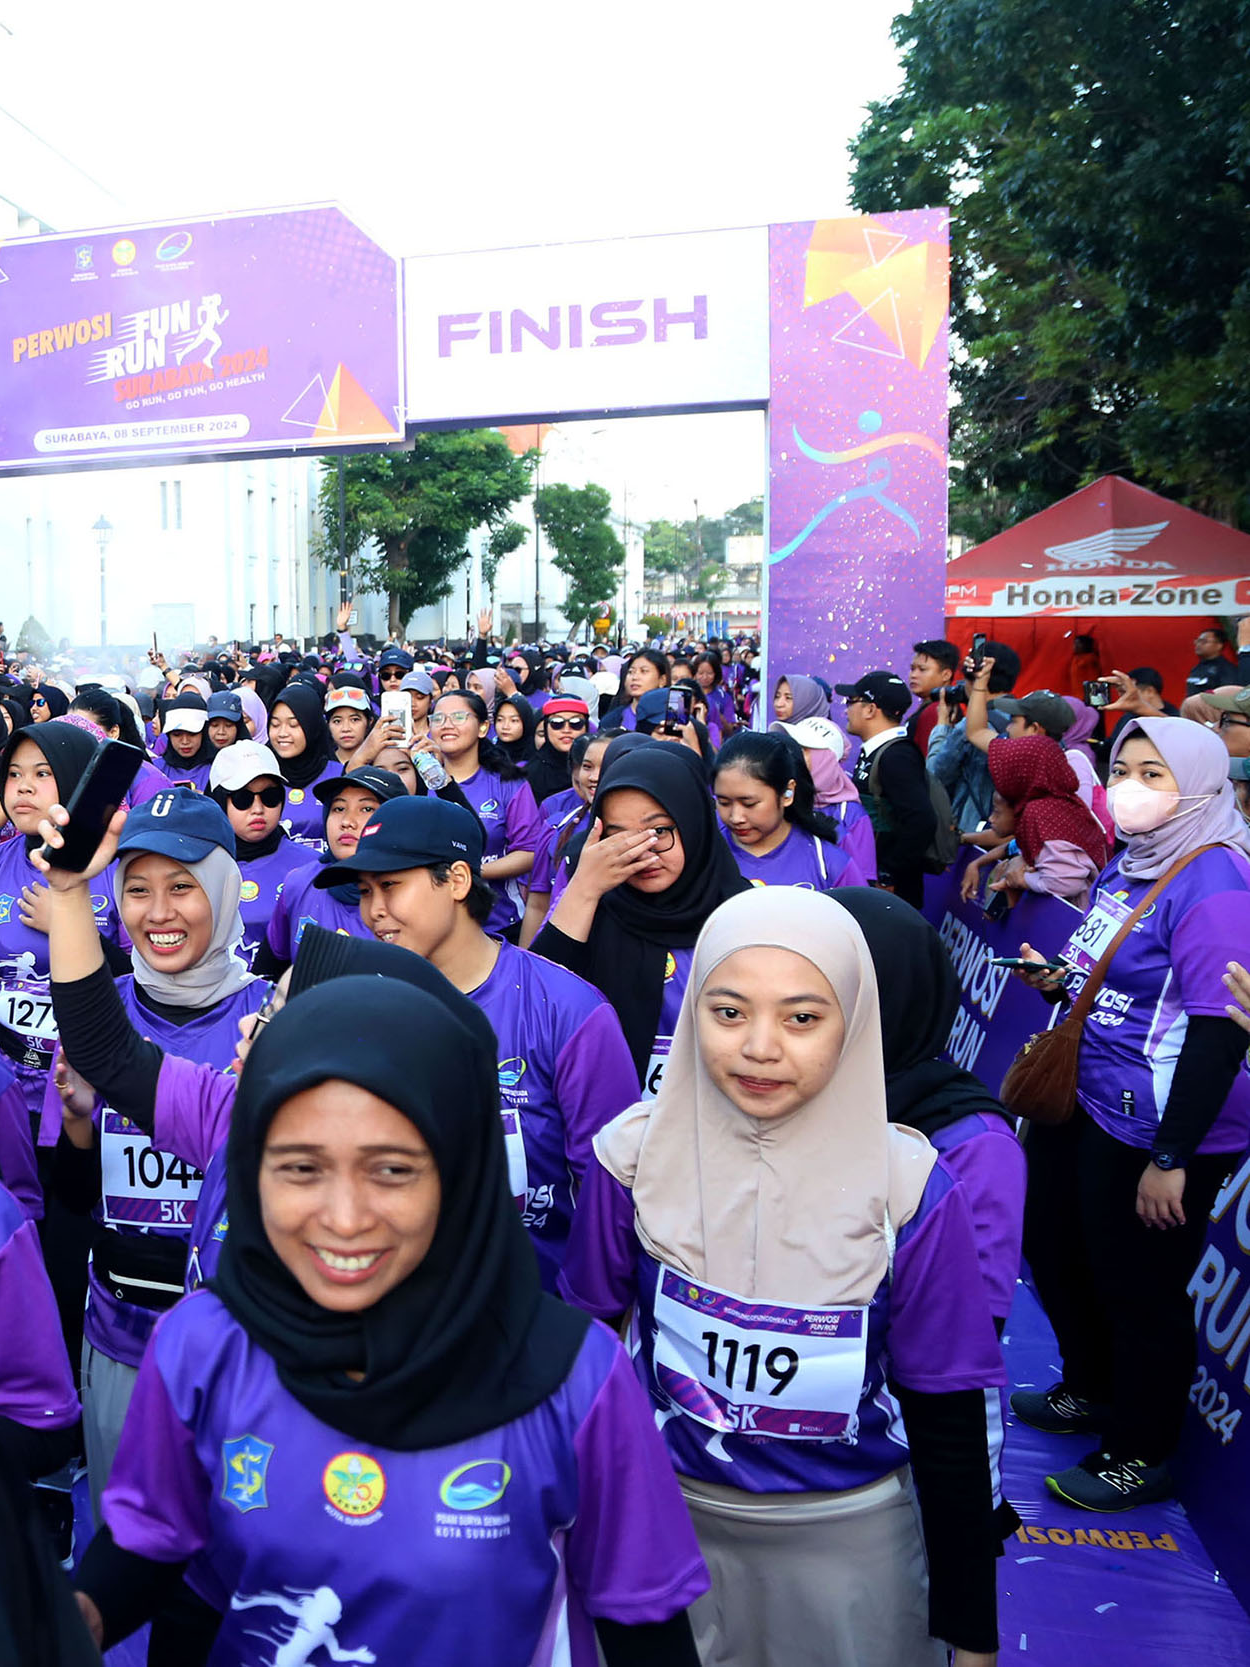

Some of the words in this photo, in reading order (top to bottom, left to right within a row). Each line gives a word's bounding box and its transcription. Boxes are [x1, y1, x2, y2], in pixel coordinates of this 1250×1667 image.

[12, 311, 113, 364] PERWOSI
[134, 299, 191, 340] FUN
[437, 294, 708, 358] FINISH
[105, 335, 166, 379] RUN
[112, 360, 215, 403] SURABAYA
[217, 345, 270, 378] 2024
[125, 400, 140, 411] GO
[141, 394, 166, 407] RUN,
[166, 390, 182, 401] GO
[183, 385, 208, 397] FUN,
[209, 381, 224, 392] GO
[225, 371, 266, 388] HEALTH
[44, 430, 112, 445] SURABAYA,
[113, 427, 129, 439] 08
[131, 422, 206, 439] SEPTEMBER
[208, 419, 239, 432] 2024
[1044, 558, 1177, 572] HONDA
[1006, 582, 1120, 607] Honda
[1129, 583, 1224, 607] Zone
[938, 910, 1012, 1021] PERWOSI
[1066, 944, 1082, 963] 5K
[7, 997, 58, 1033] 127
[26, 1036, 45, 1050] 5K
[944, 1004, 987, 1073] RUN
[160, 1200, 188, 1222] 5K
[802, 1313, 841, 1323] PERWOSI
[701, 1331, 800, 1397] 1119
[725, 1402, 761, 1430] 5K
[1188, 1364, 1243, 1446] 2024
[434, 1526, 462, 1539] KOTA
[1015, 1524, 1182, 1552] PERWOSI
